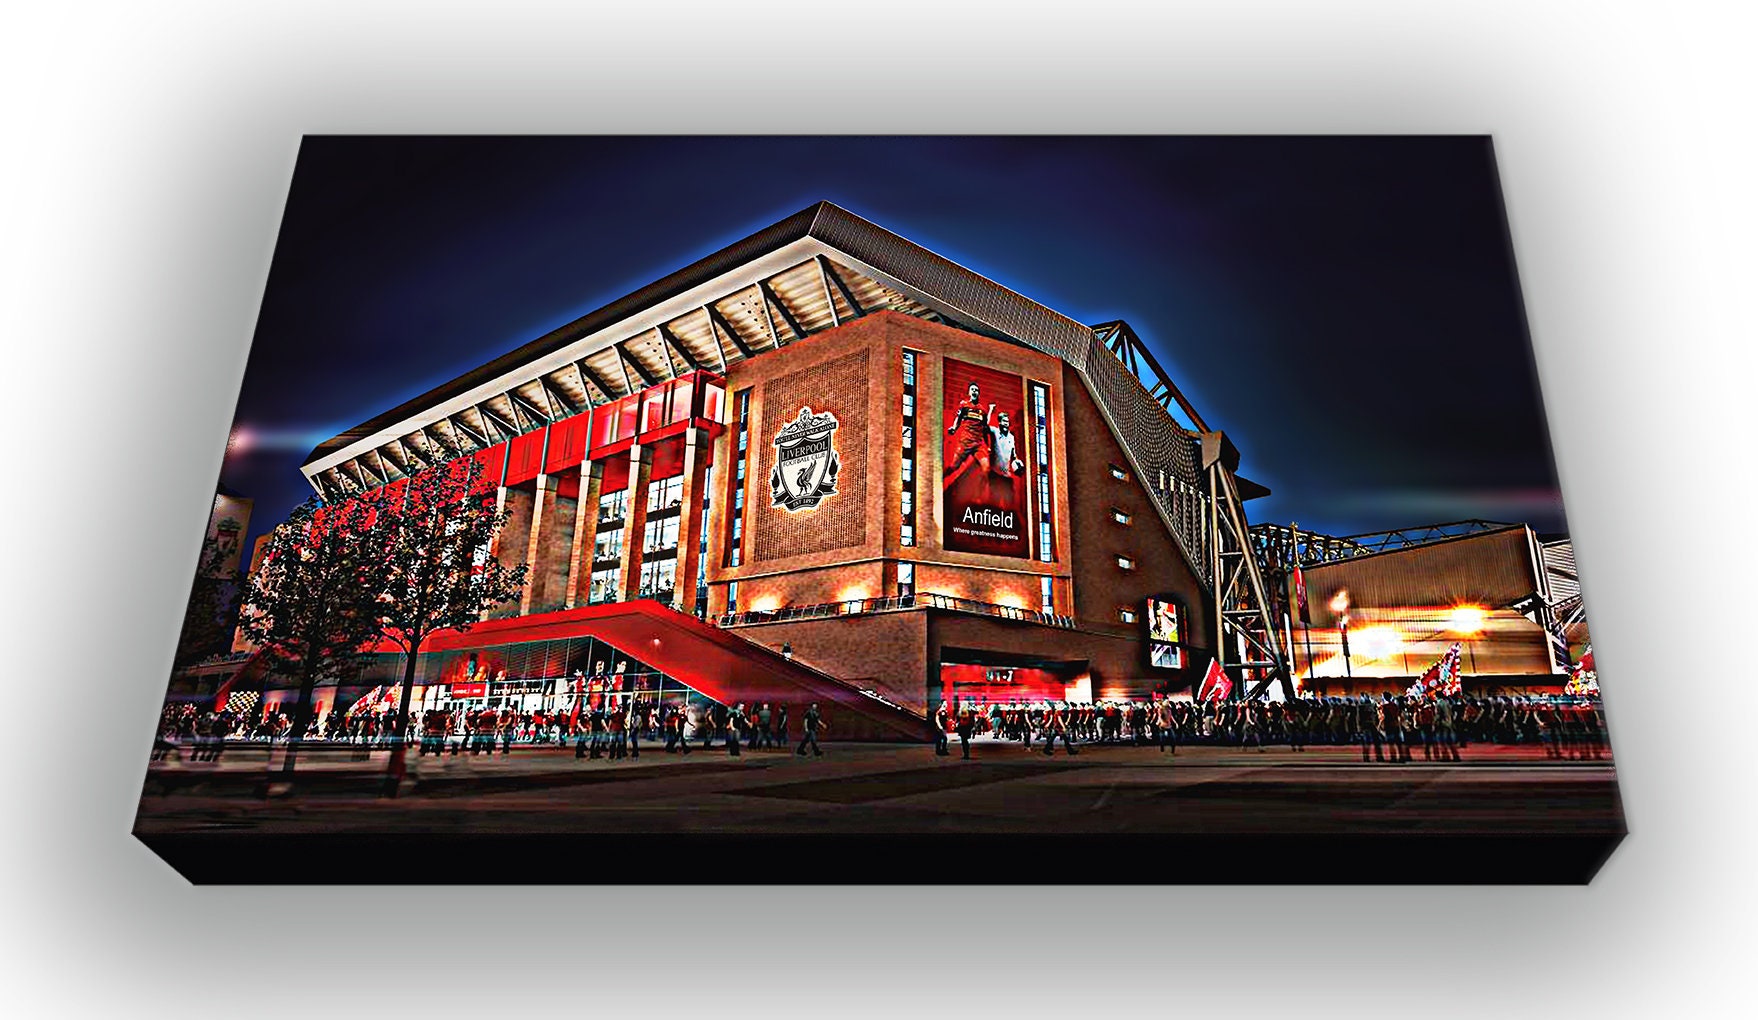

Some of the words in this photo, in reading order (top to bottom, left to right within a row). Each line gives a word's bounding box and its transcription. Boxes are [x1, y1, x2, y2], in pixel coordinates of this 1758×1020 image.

[782, 440, 828, 461] LIVERPOOL
[783, 456, 810, 467] FOOTBALL
[811, 452, 826, 461] CLUB
[962, 506, 1013, 529] Anfield
[996, 532, 1018, 540] happens
